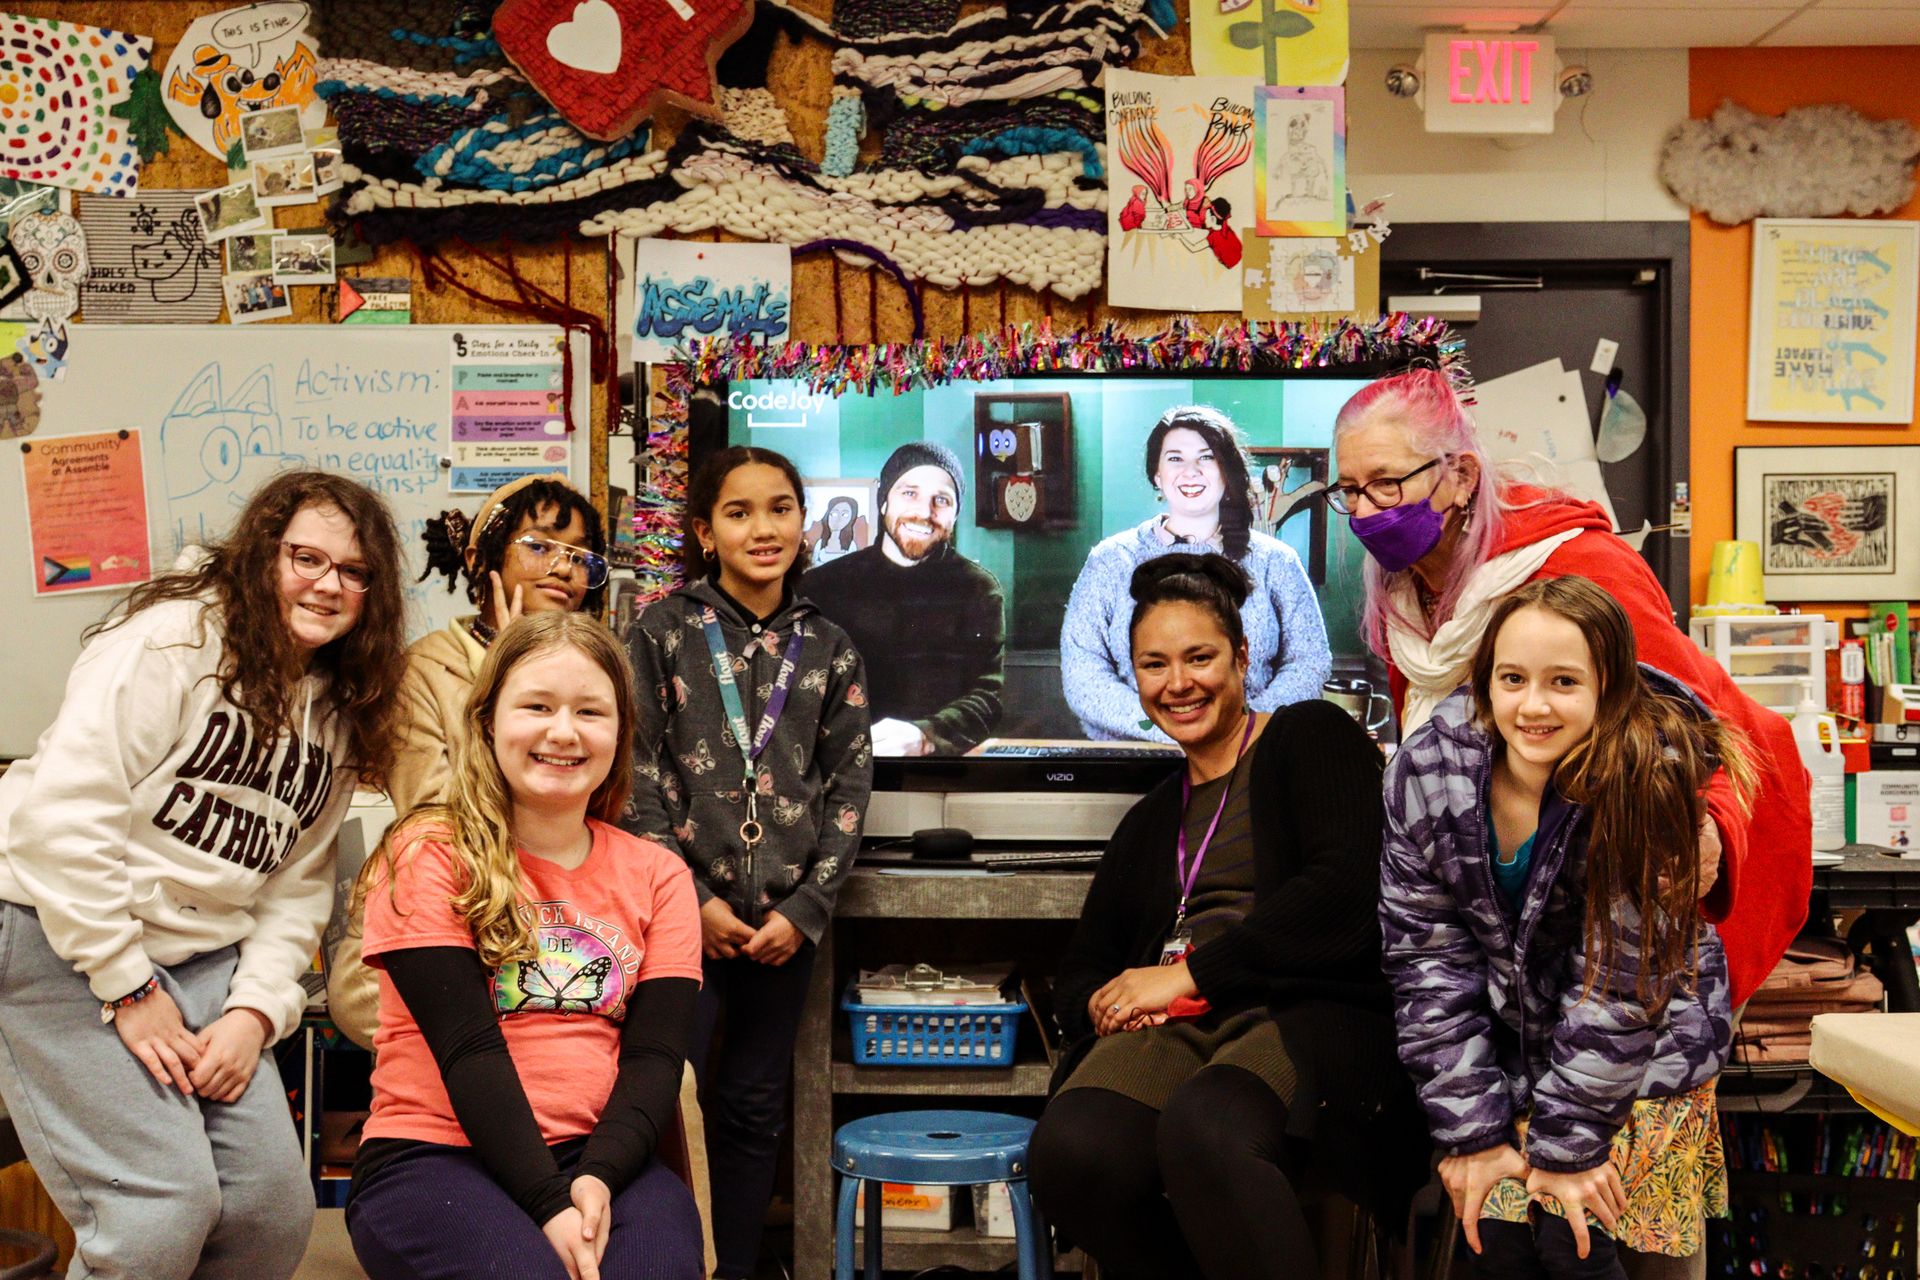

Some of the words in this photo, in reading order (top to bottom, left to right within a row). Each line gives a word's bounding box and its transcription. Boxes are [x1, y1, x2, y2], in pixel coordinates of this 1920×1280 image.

[222, 25, 243, 38] THIS
[249, 22, 260, 32] IS
[1449, 40, 1539, 104] EXIT
[1112, 92, 1151, 108] BUILDING
[1210, 97, 1254, 119] BUILDIN
[1207, 112, 1252, 137] POWER
[457, 341, 467, 357] 5
[495, 339, 504, 348] for
[517, 340, 539, 349] Daily
[296, 358, 439, 396] Activism:
[458, 371, 468, 385] P
[456, 396, 469, 410] A
[728, 391, 826, 414] CodeJoy
[291, 416, 320, 441] To
[327, 414, 358, 440] be
[364, 416, 438, 442] active
[458, 422, 466, 436] S
[40, 439, 121, 456] Community
[52, 453, 109, 467] Agreements
[65, 463, 110, 474] Assemble
[313, 447, 341, 469] in
[348, 448, 440, 483] equality
[455, 472, 468, 486] A
[715, 651, 735, 685] float
[775, 658, 795, 690] float
[753, 713, 775, 748] float
[1046, 773, 1074, 781] VIZIO
[574, 911, 640, 975] ISLAND
